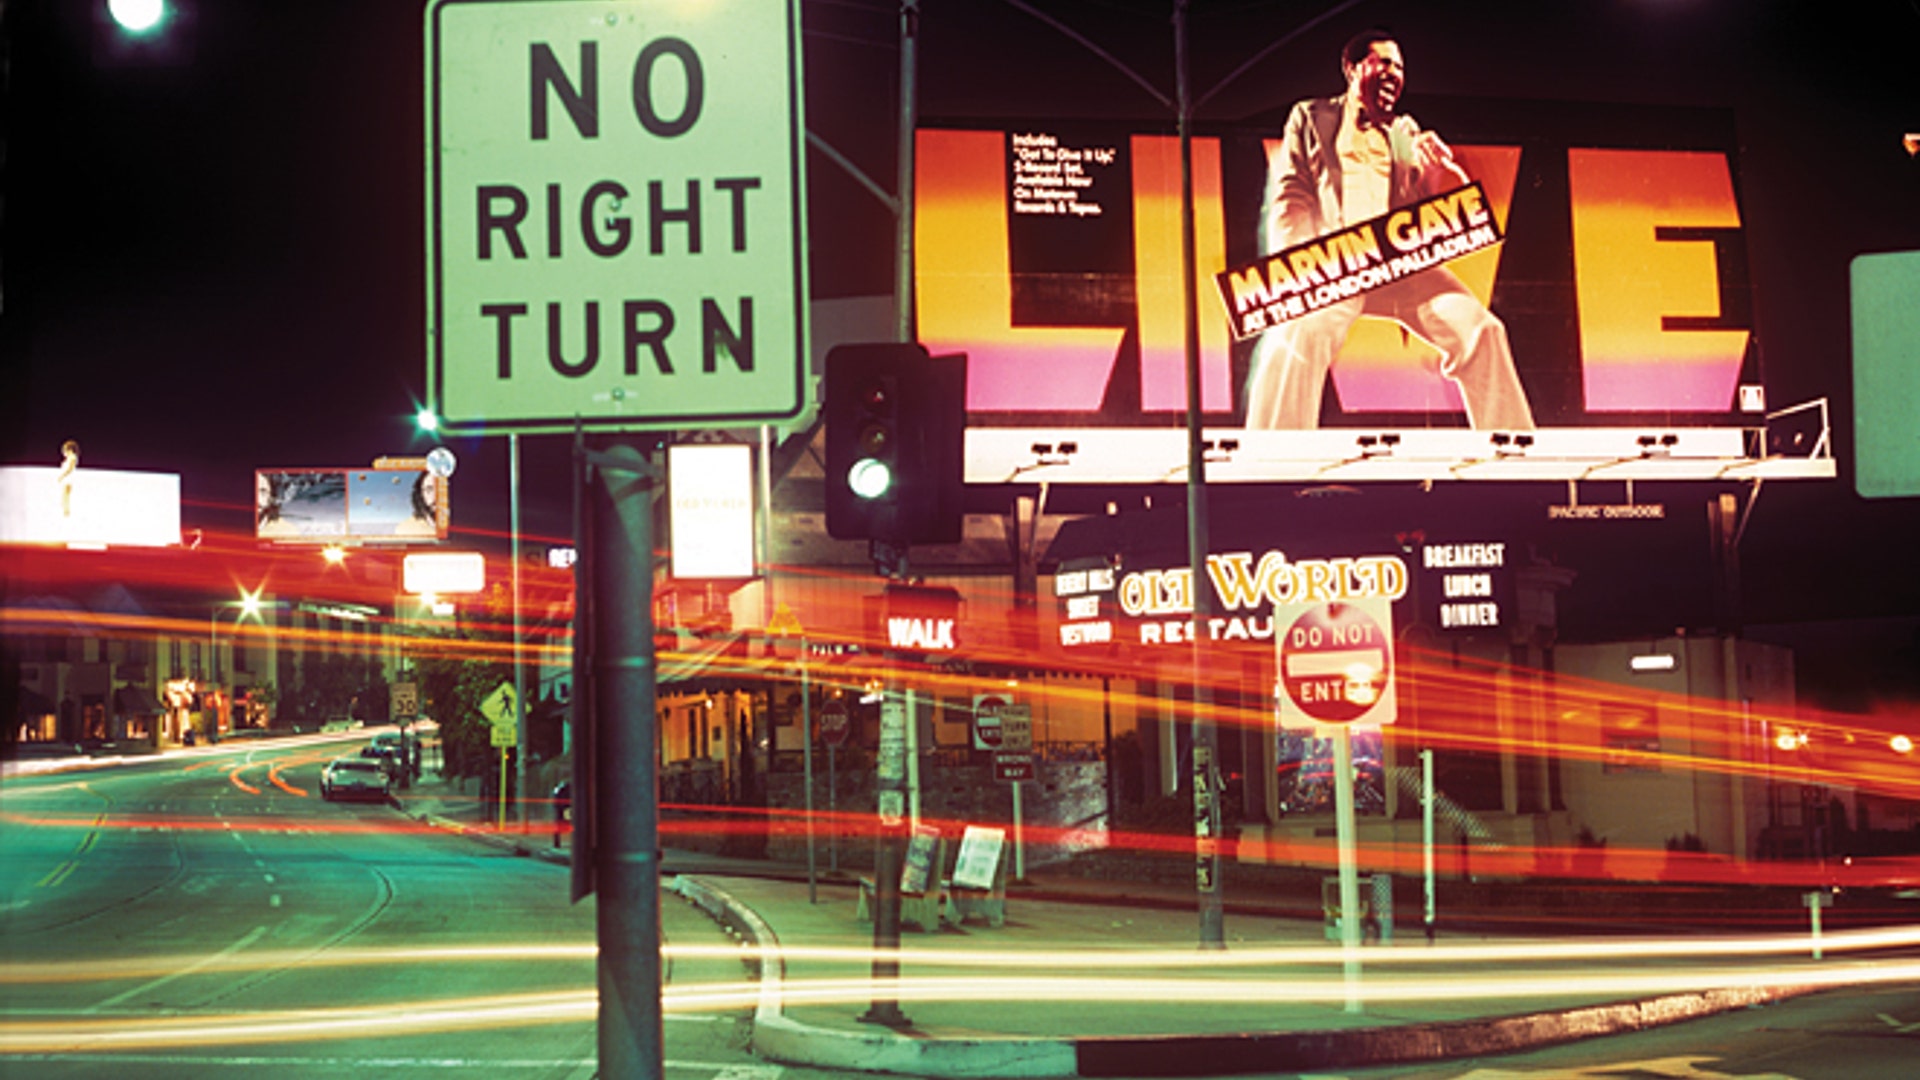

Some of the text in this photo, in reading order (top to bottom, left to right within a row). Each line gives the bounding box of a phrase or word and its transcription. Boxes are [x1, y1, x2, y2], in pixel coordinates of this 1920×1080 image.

[530, 37, 705, 140] NO
[1013, 133, 1058, 147] Includes
[1042, 149, 1055, 161] To
[1057, 149, 1081, 162] Give
[1015, 174, 1093, 187] Available Now
[1014, 188, 1078, 199] On Motown
[477, 177, 762, 259] RIGHT
[1015, 201, 1055, 213] Records
[1229, 185, 1490, 313] MARVIN GAYE
[1243, 228, 1496, 333] AT THE LONDON PALLADIUM
[481, 297, 755, 379] TURN
[1424, 543, 1504, 568] BREAKFAST
[1443, 574, 1491, 597] LUNCH
[1441, 602, 1498, 627] DINNER
[888, 618, 954, 648] WALK
[1293, 624, 1374, 648] DO NOT
[821, 714, 847, 731] STOP
